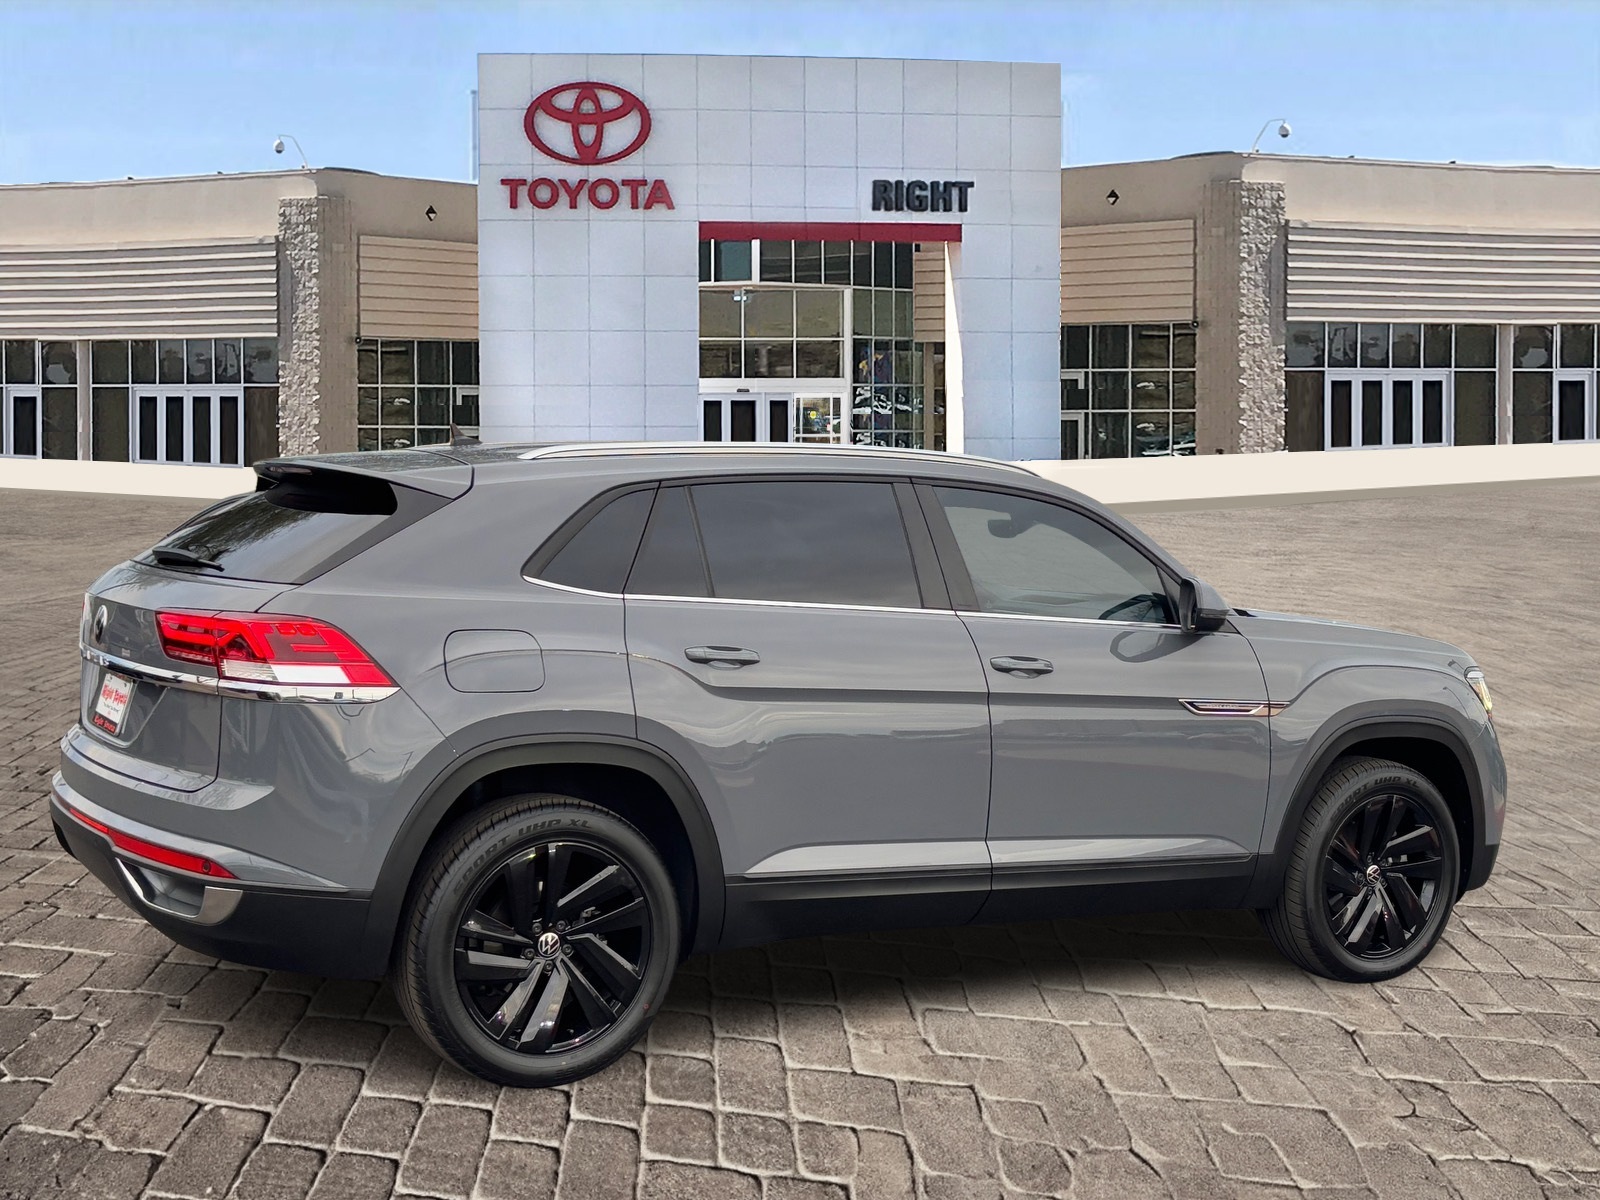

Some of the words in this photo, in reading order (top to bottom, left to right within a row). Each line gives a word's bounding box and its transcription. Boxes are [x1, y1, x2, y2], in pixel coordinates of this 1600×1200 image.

[500, 177, 676, 210] TOYOTA
[871, 179, 975, 212] RIGHT
[518, 819, 562, 836] UHP
[567, 819, 593, 828] XL
